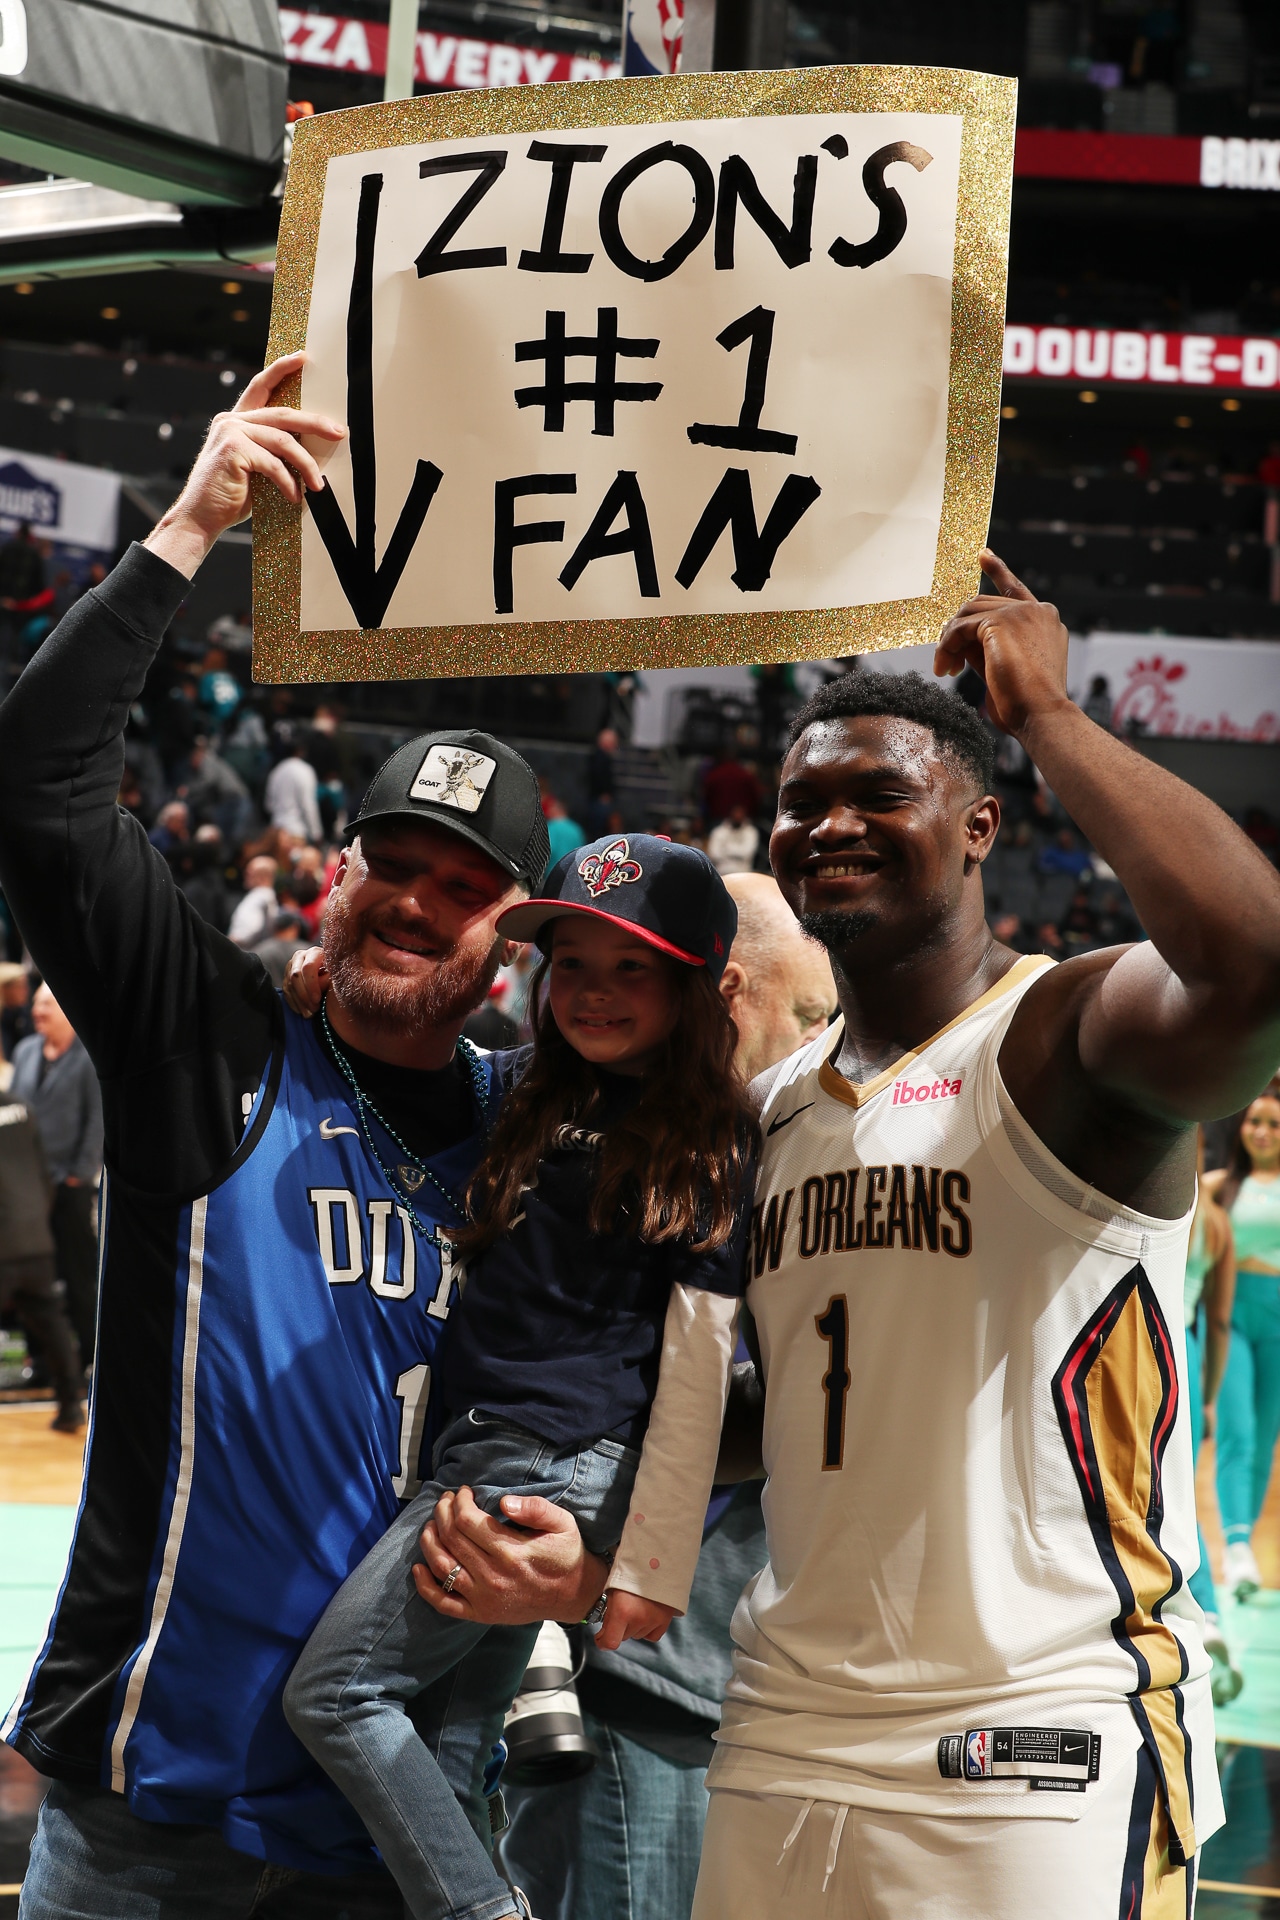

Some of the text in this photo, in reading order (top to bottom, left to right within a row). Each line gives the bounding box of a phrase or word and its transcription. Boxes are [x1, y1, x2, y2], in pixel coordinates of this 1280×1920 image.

[413, 32, 557, 88] VERY
[415, 133, 934, 282] ZION'S
[493, 468, 823, 614] FAN
[418, 778, 442, 788] GOAT
[892, 1078, 963, 1106] ibotta
[798, 1163, 973, 1259] ORLEANS
[814, 1293, 852, 1472] 1
[391, 1362, 432, 1500] 1
[997, 1741, 1009, 1751] 54
